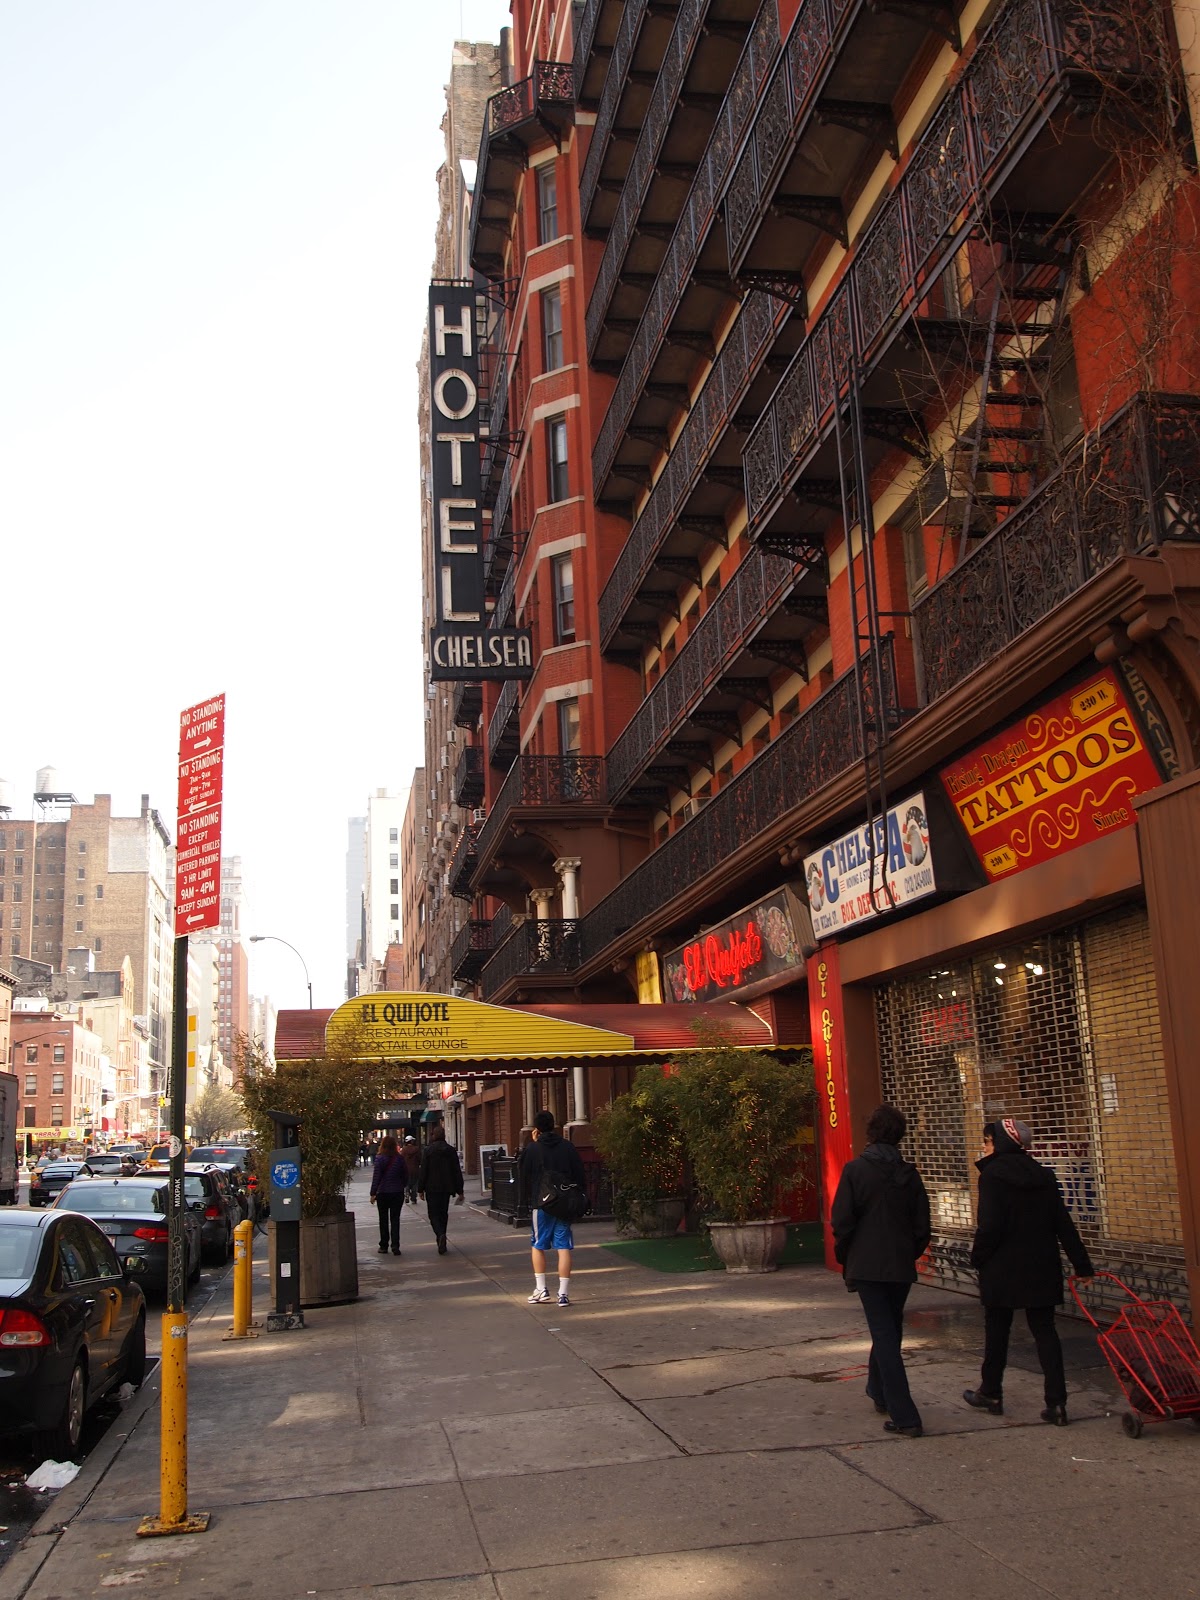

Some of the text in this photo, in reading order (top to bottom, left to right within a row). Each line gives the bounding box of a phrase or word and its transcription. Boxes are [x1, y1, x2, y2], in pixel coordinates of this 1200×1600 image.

[433, 304, 480, 622] HOTEL
[433, 635, 531, 669] CHELSEA
[181, 699, 223, 727] NO STANDING
[1080, 695, 1097, 711] 230
[186, 717, 218, 740] ANYTIME
[180, 752, 221, 778] NO STANDING
[945, 738, 1030, 796] Rising Dragon
[959, 716, 1137, 829] TATTOOS
[184, 789, 216, 806] EXCEPT SUNDAY
[179, 811, 219, 836] NO STANDING
[1091, 807, 1129, 832] Since
[188, 830, 209, 845] EXCEPT
[177, 839, 220, 861] COMMERCIAL VEHICLES
[178, 852, 219, 874] METERED PARKING
[188, 872, 197, 883] HR
[198, 867, 212, 880] LIMIT
[180, 886, 195, 900] 9AM
[200, 880, 215, 895] 4PM
[177, 895, 218, 915] EXCEPT SUNDAY
[841, 900, 856, 923] BOX
[857, 888, 881, 916] DEPT
[683, 943, 706, 991] El
[817, 962, 828, 998] El
[361, 1002, 450, 1026] EL QUIJOTE
[366, 1027, 451, 1038] RESTAURANT
[354, 1039, 468, 1051] OCKTAIL LOUNGE
[287, 1128, 293, 1145] P
